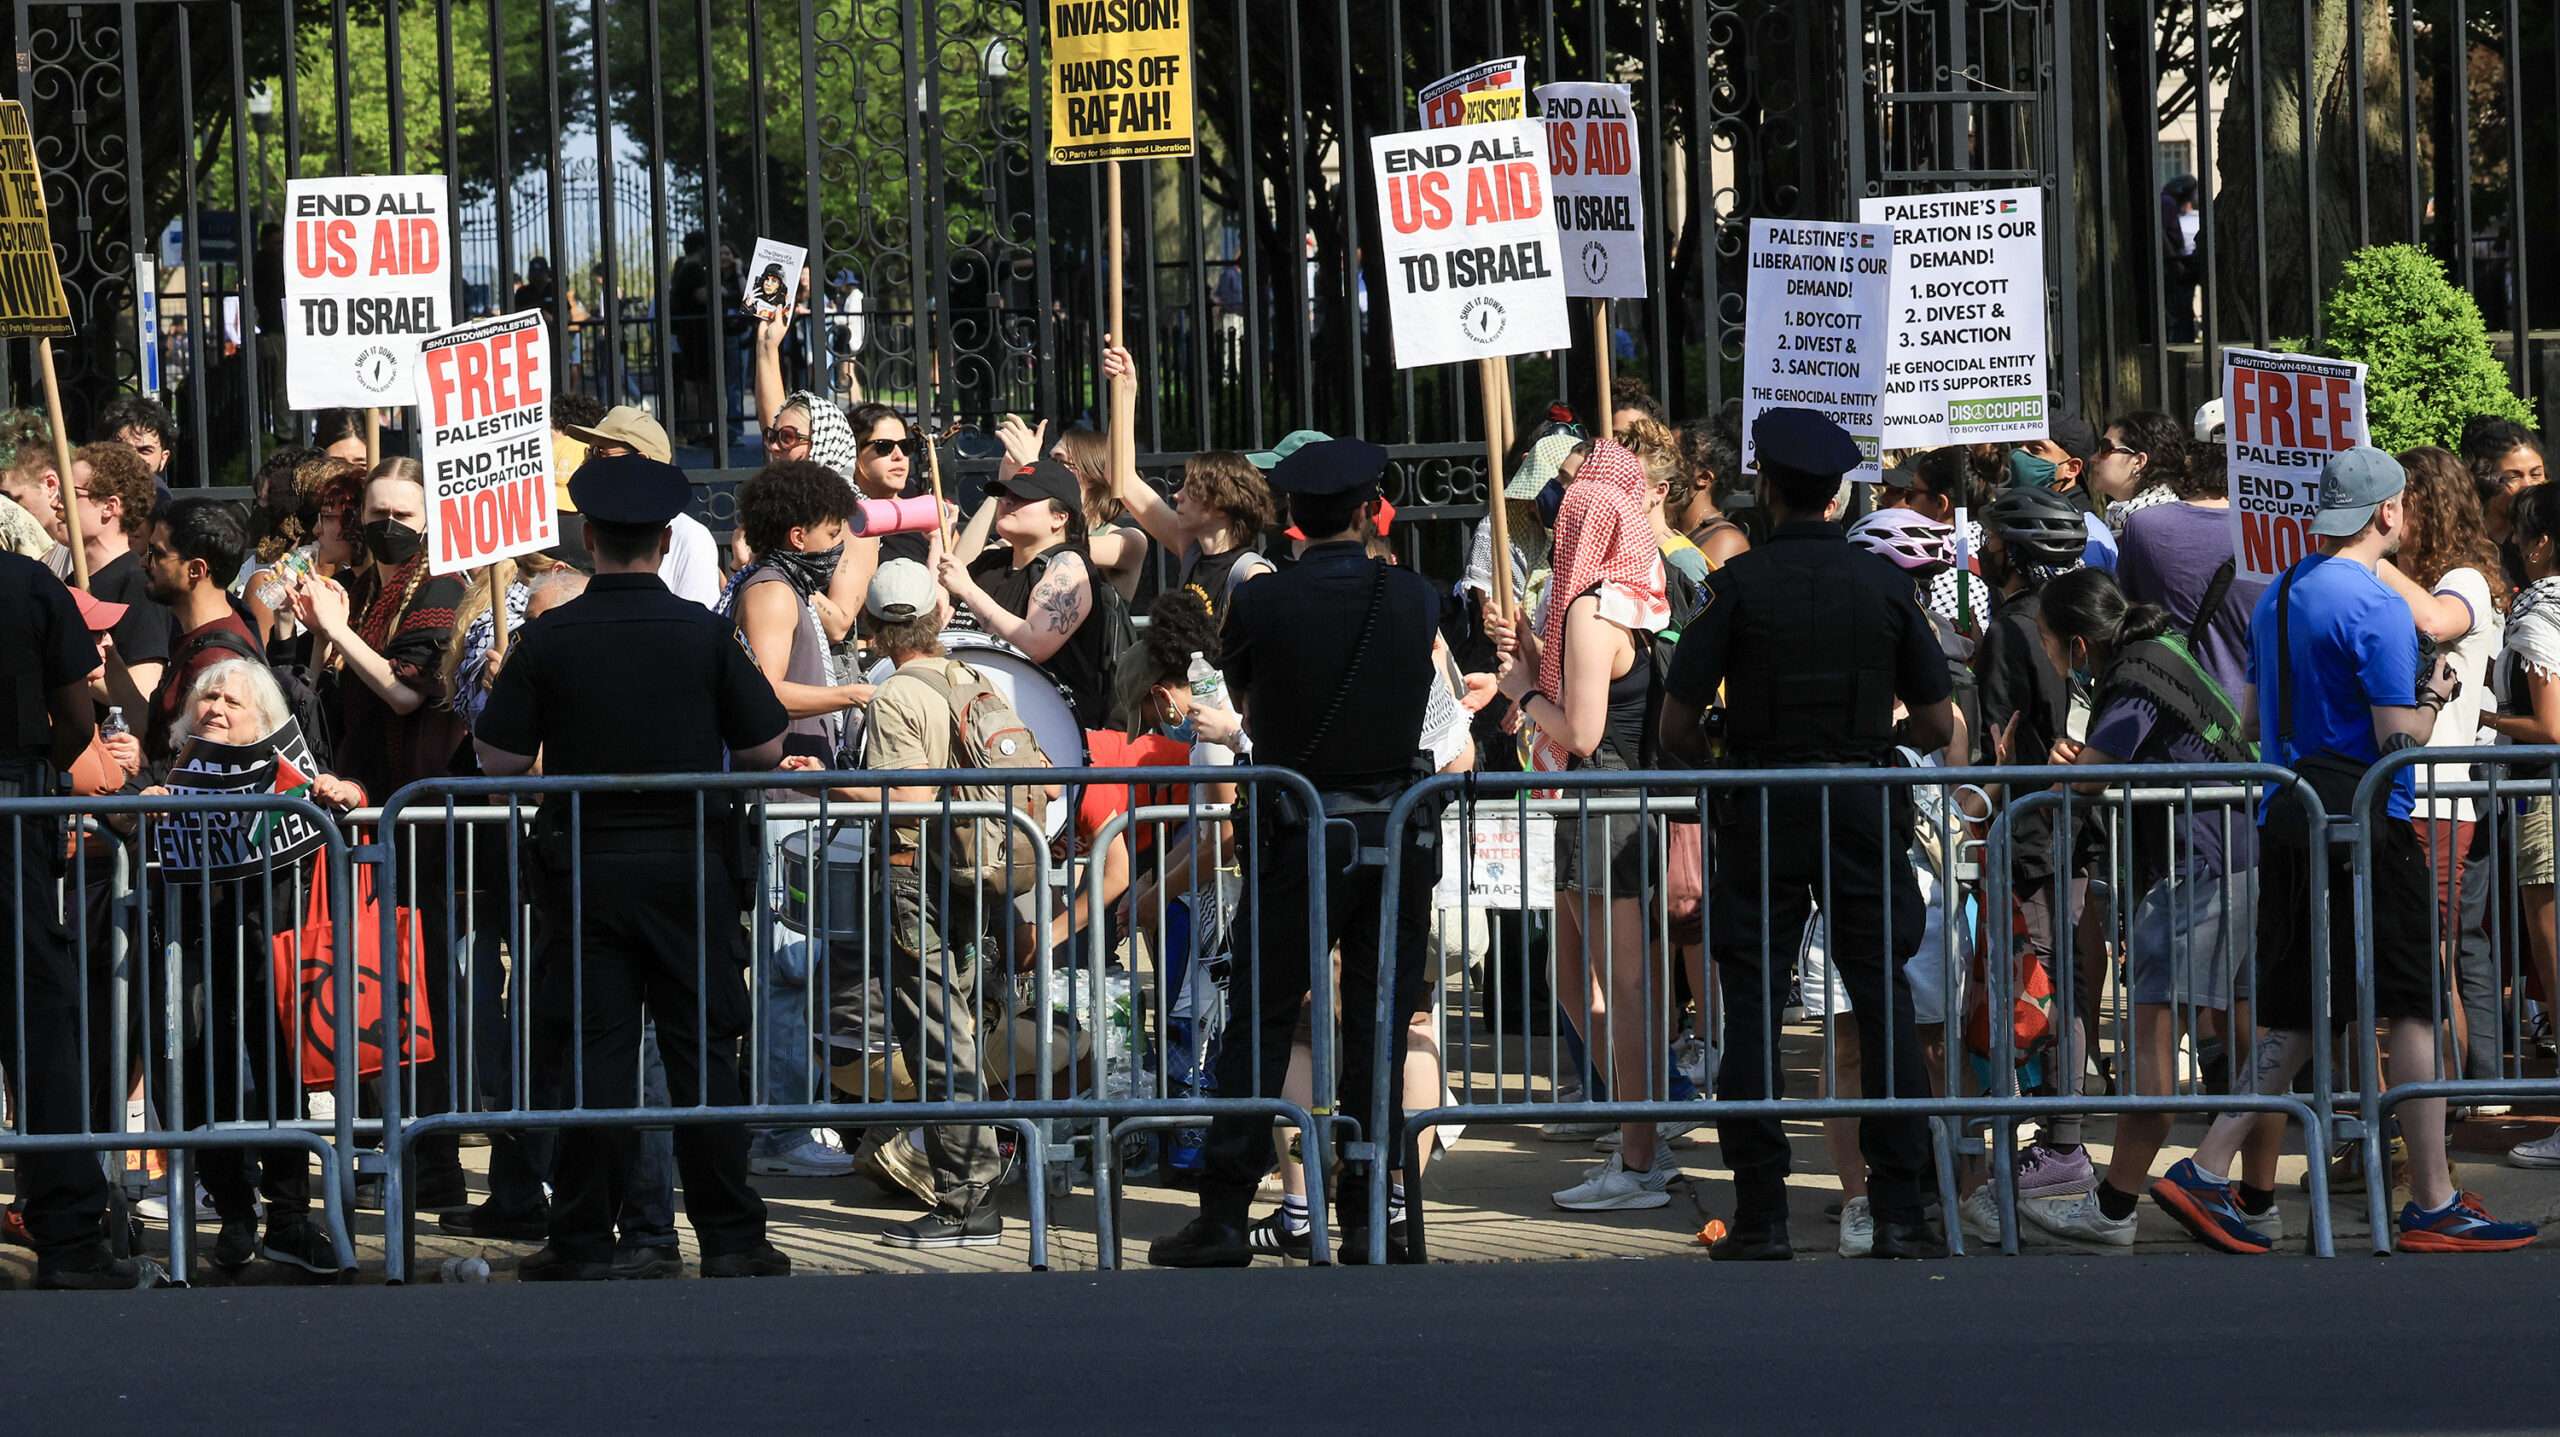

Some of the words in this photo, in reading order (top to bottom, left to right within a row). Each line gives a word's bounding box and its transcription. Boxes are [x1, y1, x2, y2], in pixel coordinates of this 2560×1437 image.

[1056, 0, 1179, 38] INVASION!
[1060, 58, 1133, 94] HANDS
[1139, 55, 1180, 87] OFF
[1068, 91, 1171, 137] RAFAH!
[1547, 98, 1583, 119] END
[1586, 98, 1626, 119] ALL
[1069, 150, 1087, 160] Party
[1088, 149, 1098, 158] for
[1134, 145, 1149, 154] and
[1150, 143, 1190, 153] Liberation
[1384, 143, 1462, 174] END
[1467, 136, 1534, 164] ALL
[1546, 122, 1577, 176] US
[1584, 122, 1631, 176] AID
[9, 173, 43, 217] THE
[296, 194, 371, 217] END
[375, 192, 435, 216] ALL
[1388, 170, 1453, 234] US
[1465, 161, 1542, 226] AID
[1575, 196, 1635, 231] ISRAEL
[1894, 225, 1972, 246] ERATION
[1977, 223, 1993, 240] IS
[1998, 221, 2037, 239] OUR
[296, 219, 358, 278] US
[369, 218, 440, 276] AID
[1910, 249, 1994, 269] DEMAND!
[1399, 252, 1439, 294] TO
[1449, 240, 1551, 289] ISRAEL
[1752, 252, 1836, 273] LIBERATION
[1840, 256, 1854, 274] IS
[1858, 258, 1887, 275] OUR
[1787, 279, 1853, 298] DEMAND!
[1910, 285, 1922, 300] 1.
[1926, 279, 2008, 298] BOYCOTT
[299, 298, 339, 336] TO
[347, 296, 441, 336] ISRAEL
[1459, 300, 1475, 320] SHUT
[1474, 296, 1482, 306] IT
[1905, 308, 1921, 324] 2.
[1927, 304, 1986, 322] DIVEST
[1991, 302, 2005, 318] &
[1785, 311, 1794, 327] 1.
[1796, 311, 1862, 330] BOYCOTT
[1778, 335, 1791, 350] 2.
[1795, 336, 1842, 353] DIVEST
[1846, 338, 1857, 354] &
[1899, 332, 1915, 348] 3.
[1921, 326, 2011, 346] SANCTION
[354, 349, 369, 368] SHUT
[370, 345, 376, 355] IT
[1886, 363, 1901, 375] HE
[1905, 358, 1985, 374] GENOCIDAL
[1990, 354, 2036, 369] ENTITY
[426, 327, 543, 427] FREE
[1772, 359, 1785, 374] 3.
[1788, 360, 1860, 378] SANCTION
[1885, 381, 1915, 394] AND
[1919, 379, 1939, 392] ITS
[1943, 373, 2032, 391] SUPPORTERS
[1752, 387, 1772, 400] THE
[1775, 389, 1838, 405] GENOCIDAL
[1841, 392, 1878, 406] ENTITY
[1824, 411, 1873, 425] PORTERS
[1884, 413, 1944, 426] OWNLOAD
[2233, 367, 2356, 452] FREE
[435, 406, 543, 447] PALESTINE
[1962, 425, 1999, 433] BOYCOTT
[2001, 423, 2018, 431] LIKE
[437, 451, 492, 482] END
[497, 437, 541, 467] THE
[2236, 445, 2334, 468] PALESTI
[438, 460, 543, 497] OCCUPATION
[2238, 475, 2294, 500] END
[440, 475, 549, 562] NOW!
[2239, 497, 2319, 517] OCCUPA
[1475, 848, 1520, 860] NTER
